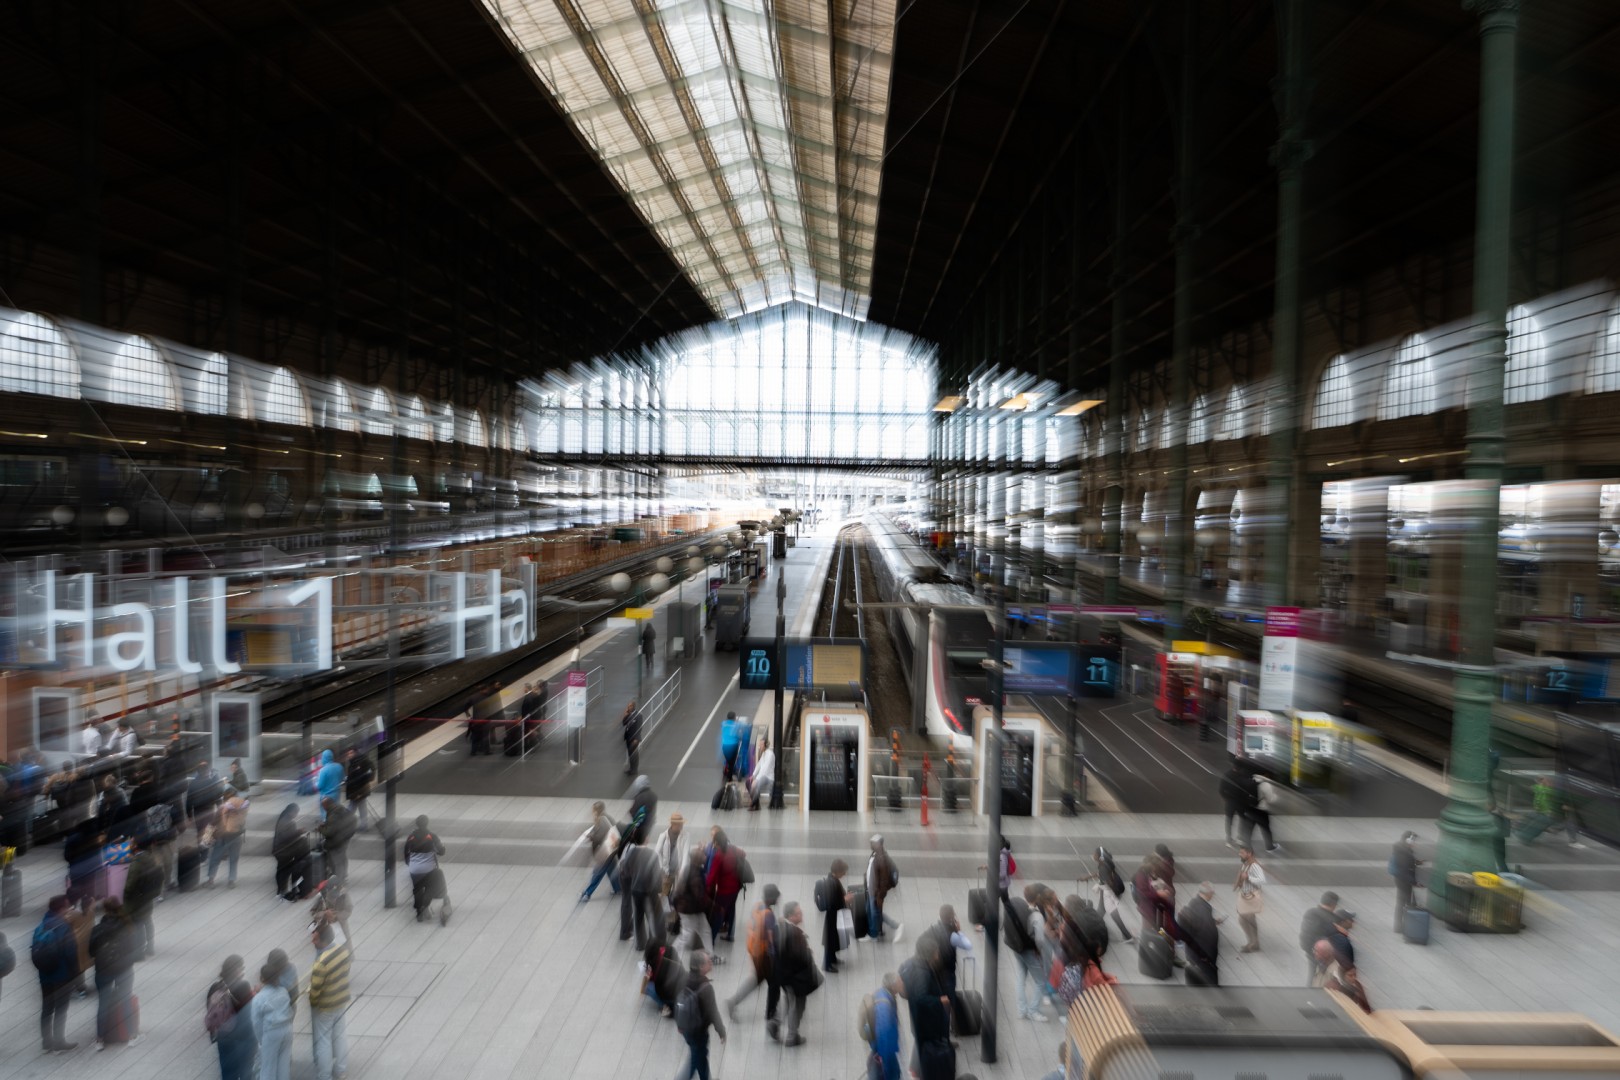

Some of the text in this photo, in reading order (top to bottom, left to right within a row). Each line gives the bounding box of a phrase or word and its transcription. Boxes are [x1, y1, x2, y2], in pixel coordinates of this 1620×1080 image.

[46, 570, 333, 674] Hall 1
[747, 657, 770, 673] 10
[1086, 665, 1109, 681] 11
[1546, 671, 1568, 687] 12
